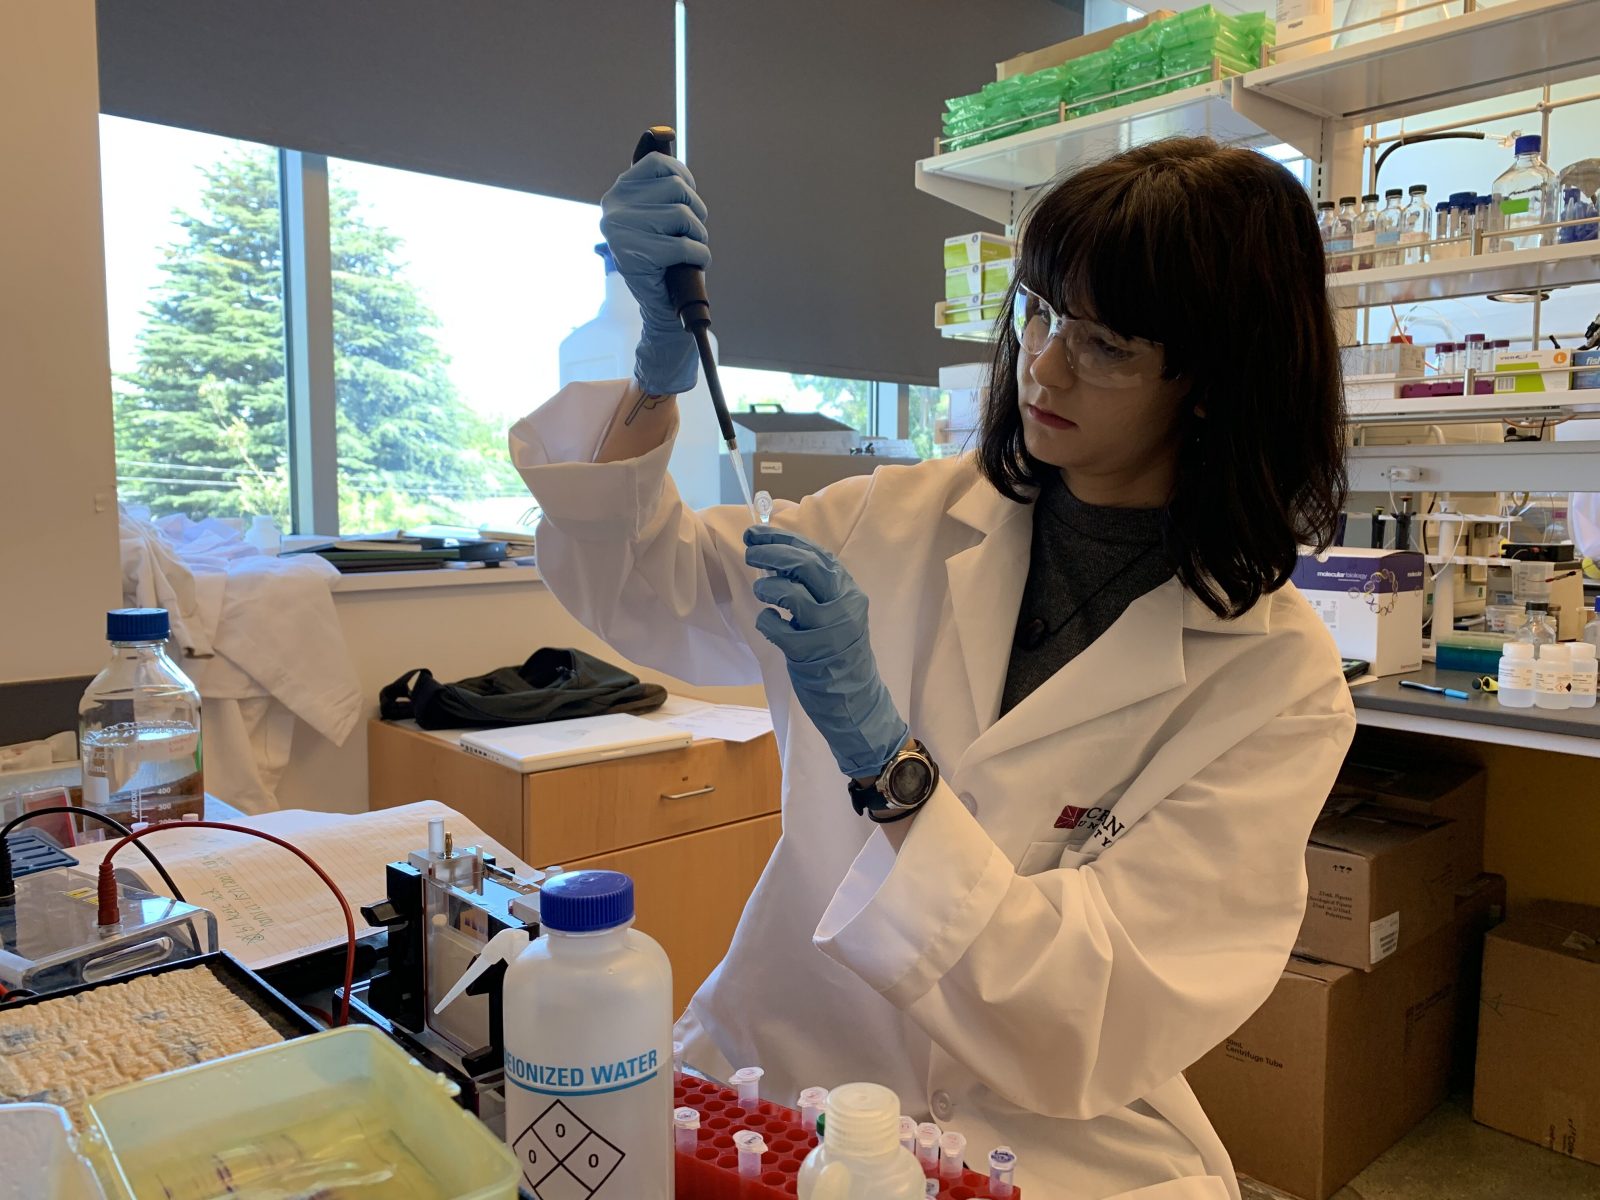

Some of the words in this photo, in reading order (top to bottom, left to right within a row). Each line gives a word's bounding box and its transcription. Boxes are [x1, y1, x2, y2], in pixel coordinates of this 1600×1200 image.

[1346, 572, 1367, 580] biology
[1225, 1044, 1264, 1062] Centrifuge
[1265, 1056, 1284, 1069] Tube
[590, 1049, 657, 1085] WATER
[555, 1123, 566, 1138] 0
[528, 1149, 537, 1164] 0
[588, 1153, 599, 1168] 0
